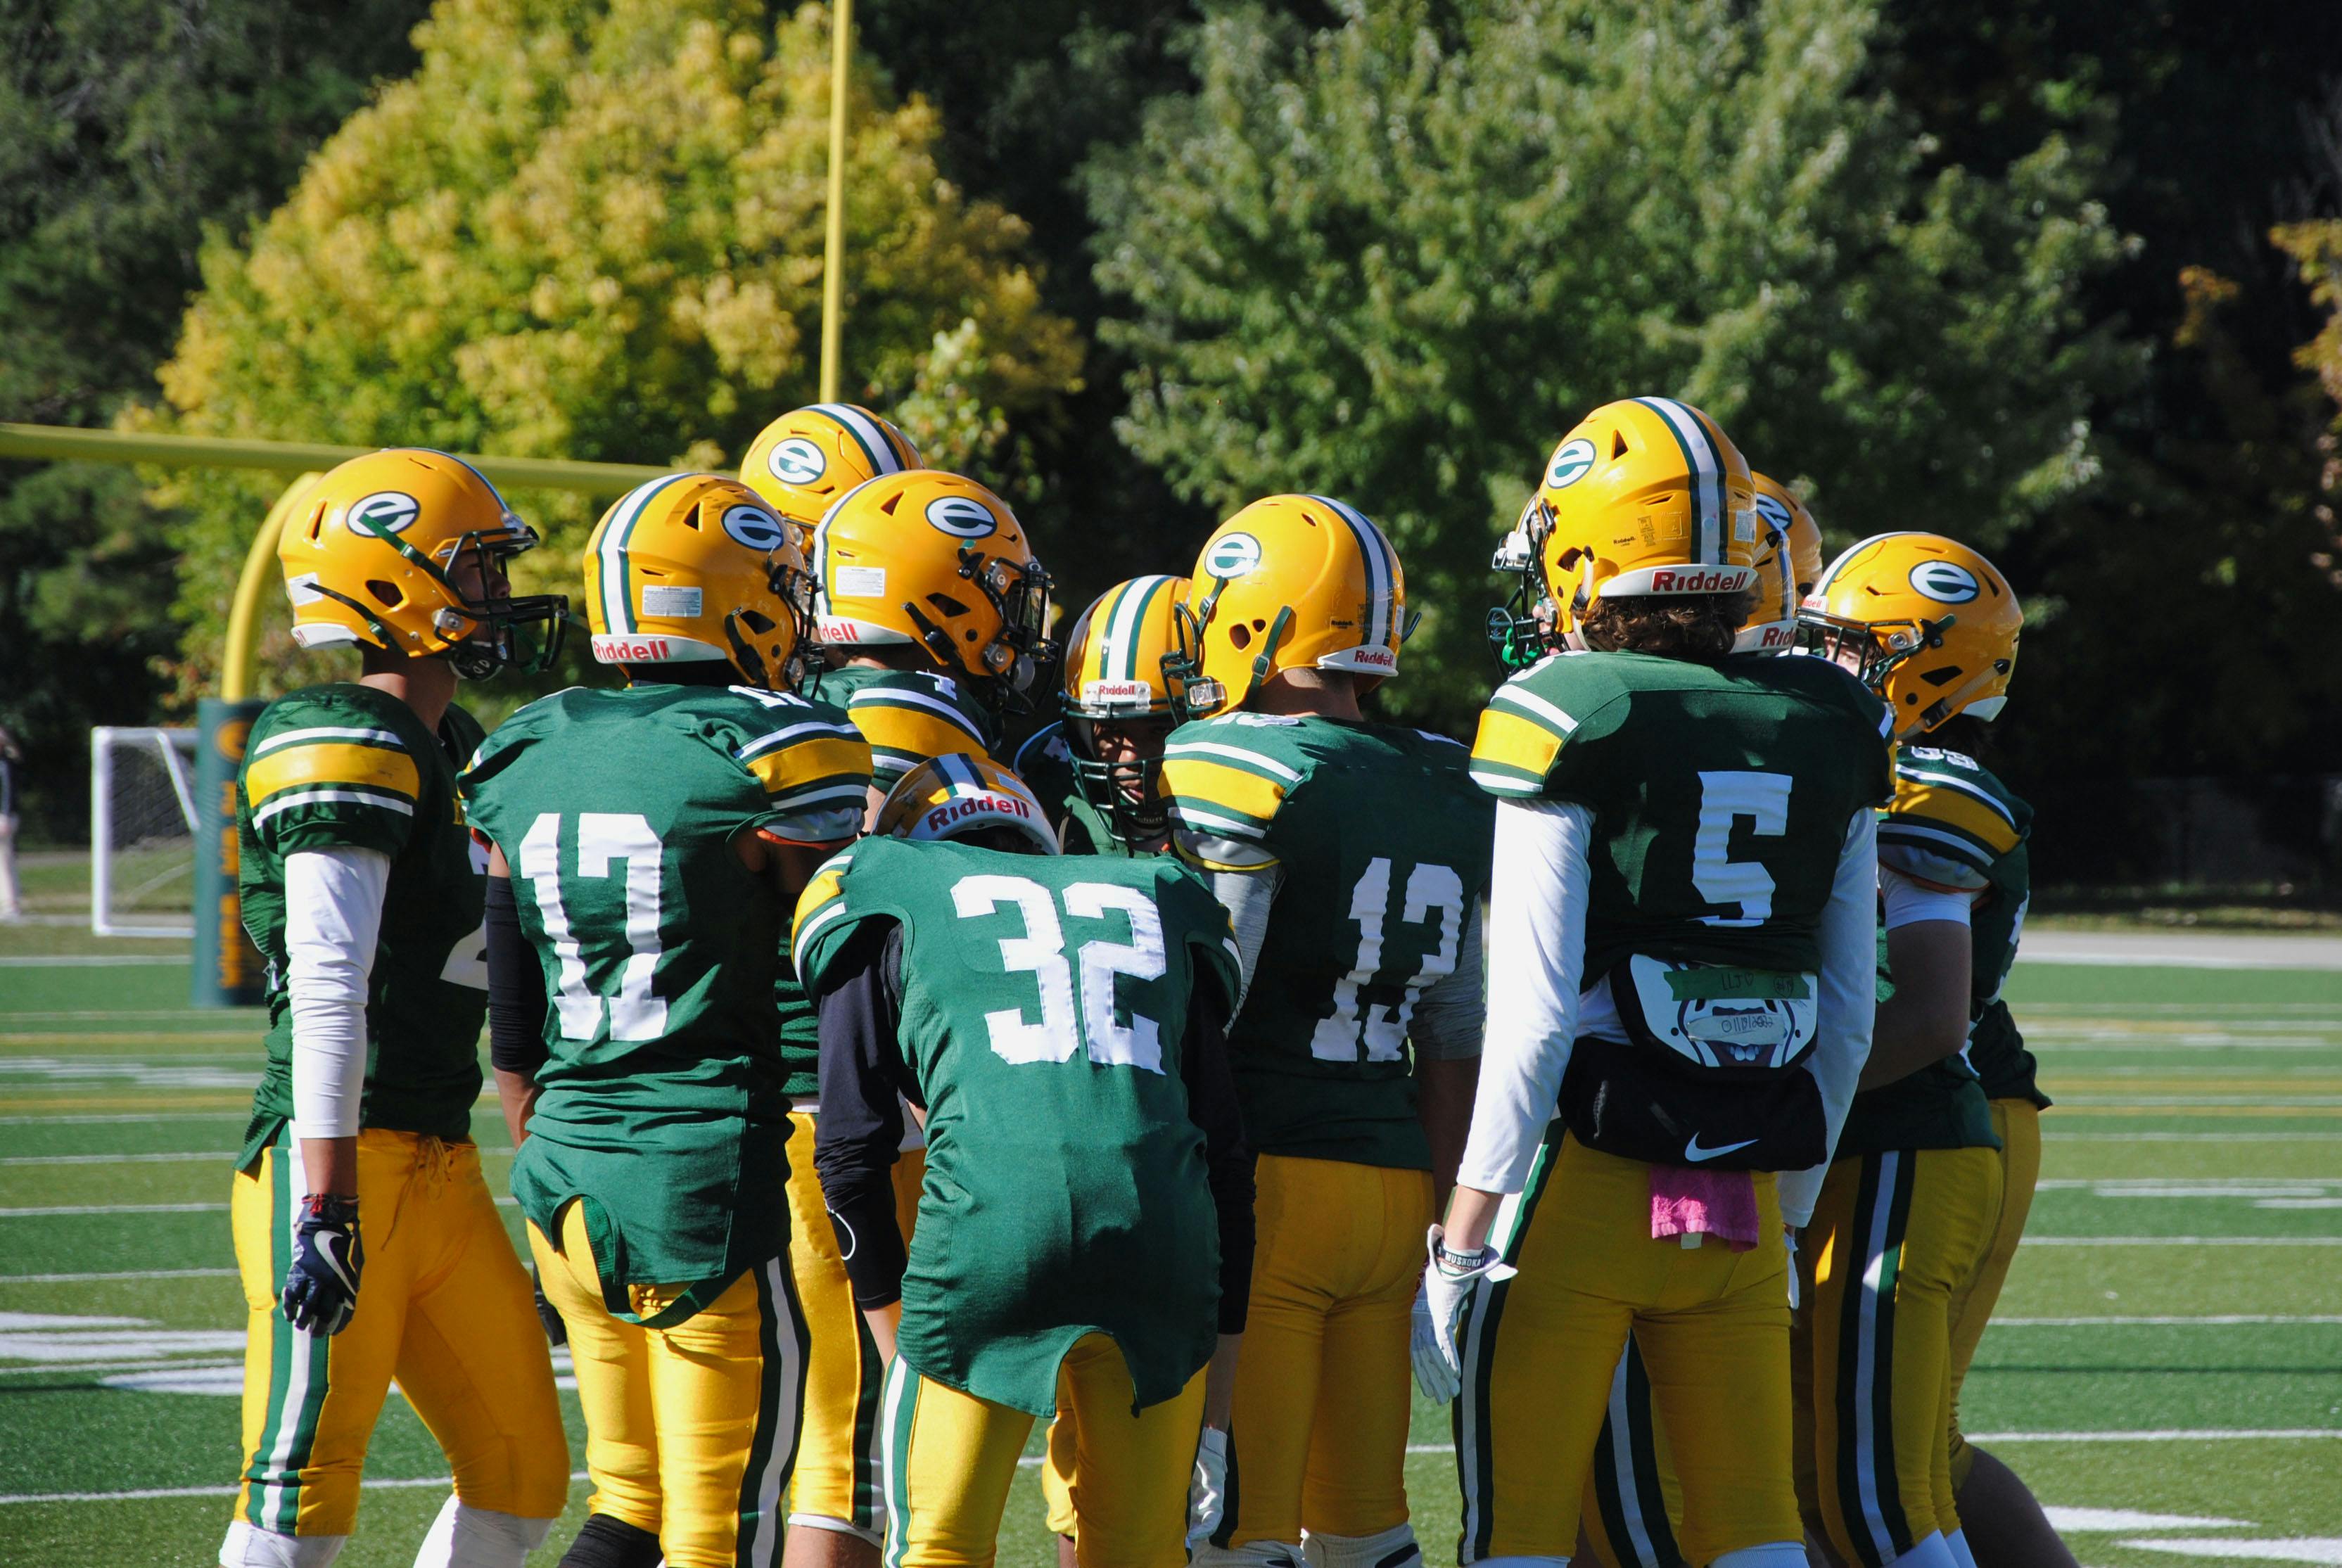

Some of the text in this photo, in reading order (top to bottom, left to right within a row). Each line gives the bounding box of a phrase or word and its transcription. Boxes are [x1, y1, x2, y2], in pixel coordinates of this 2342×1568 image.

[1653, 571, 1748, 592] Riddell
[593, 639, 670, 661] Riddell
[1354, 649, 1394, 667] Riddell
[1099, 684, 1135, 696] Riddell
[928, 795, 1030, 831] Riddell
[1693, 771, 1793, 927] 5
[519, 812, 668, 1041] 17
[950, 874, 1167, 1076] 32
[1311, 857, 1464, 1062] 13
